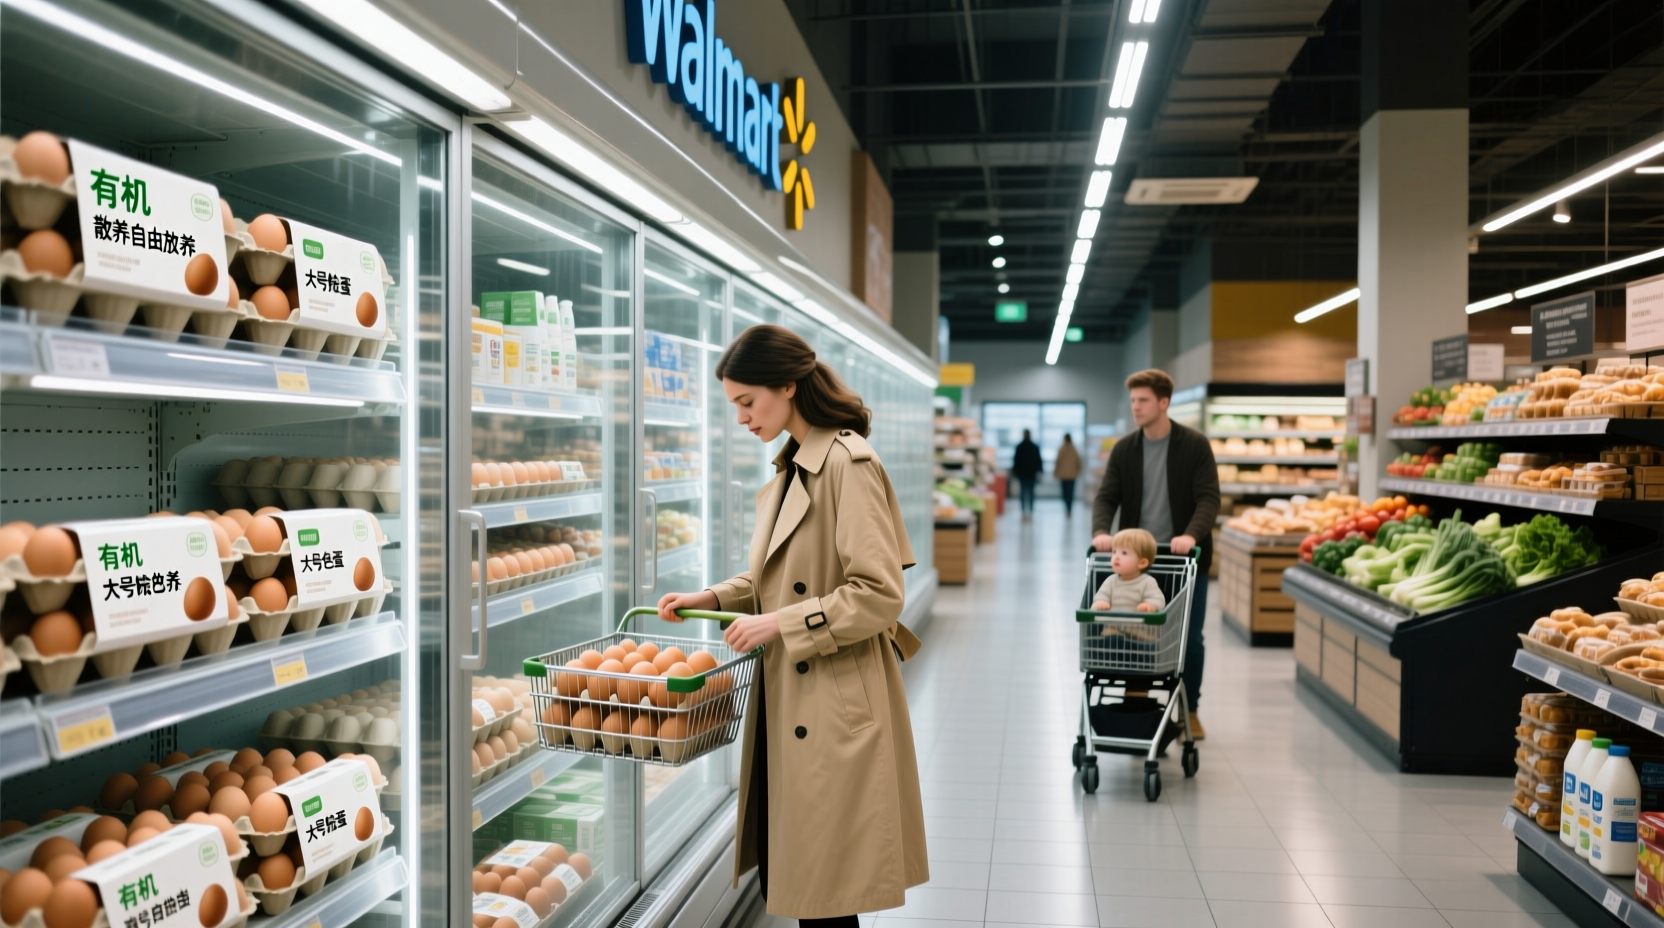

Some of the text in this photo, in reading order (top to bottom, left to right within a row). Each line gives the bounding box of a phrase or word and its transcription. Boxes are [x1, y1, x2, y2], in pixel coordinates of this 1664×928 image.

[90, 168, 152, 217] 有机
[93, 214, 197, 258] 散养自由放养
[97, 541, 144, 572] 有机
[117, 872, 160, 912] 有机
